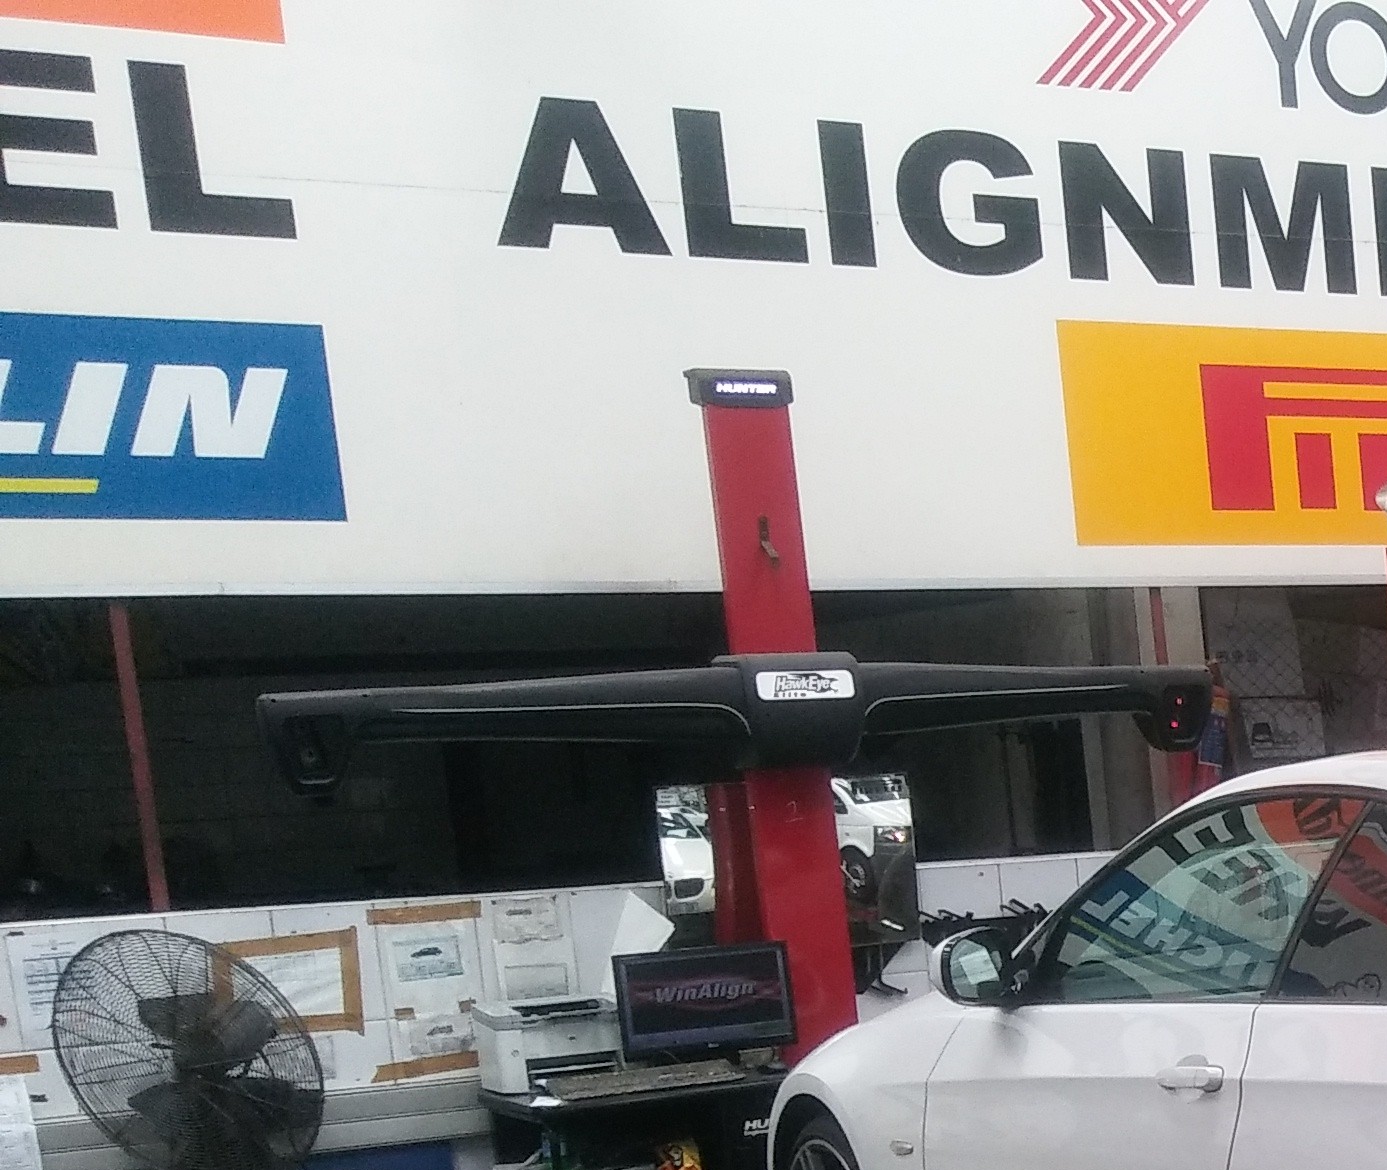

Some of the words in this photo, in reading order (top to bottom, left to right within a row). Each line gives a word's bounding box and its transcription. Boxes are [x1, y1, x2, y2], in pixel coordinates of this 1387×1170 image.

[716, 382, 777, 394] HUNTER
[775, 675, 831, 692] HawkEye
[654, 981, 756, 1003] WinAlign
